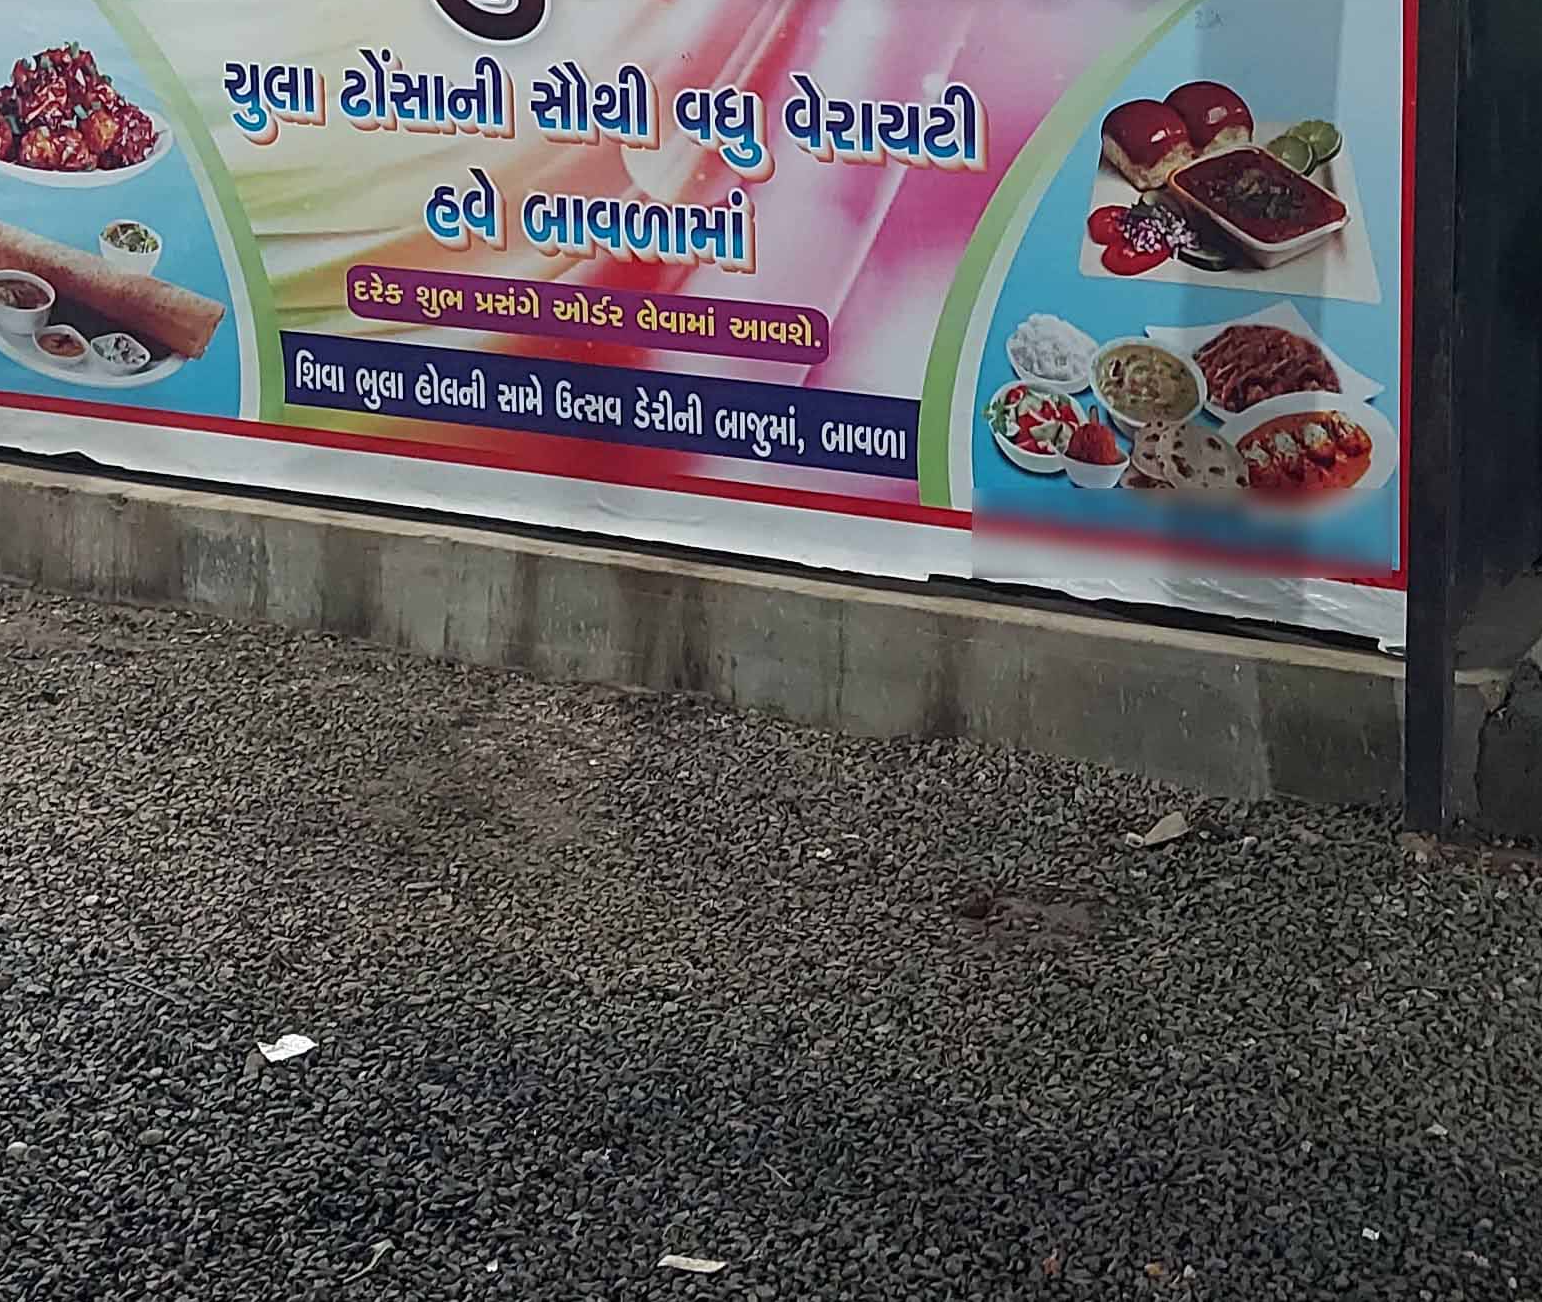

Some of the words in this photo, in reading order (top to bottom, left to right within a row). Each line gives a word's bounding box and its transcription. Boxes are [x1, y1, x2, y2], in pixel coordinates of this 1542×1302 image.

[340, 48, 505, 127] ઢોંસાની
[530, 60, 648, 137] સૌથી
[675, 86, 762, 169] વધુ
[784, 72, 977, 161] વેરાયટી
[425, 166, 498, 240] હવે
[522, 189, 745, 260] બાવળામાં
[353, 271, 404, 305] દરેક
[415, 286, 463, 319] શુભ
[474, 286, 540, 319] પ્રસંગે
[552, 293, 624, 328] ઓર્ડર
[635, 299, 716, 338] લેવામાં
[728, 314, 822, 348] આવશે.
[294, 348, 345, 393] શિવા
[355, 366, 404, 411] ભુલા
[414, 362, 486, 411] હોલની
[497, 373, 543, 416] સામે
[555, 380, 622, 426] ઉત્સવ
[632, 386, 703, 436] ડેરીની
[714, 405, 806, 458] બાજુમાં,
[820, 420, 907, 461] બાવળા
